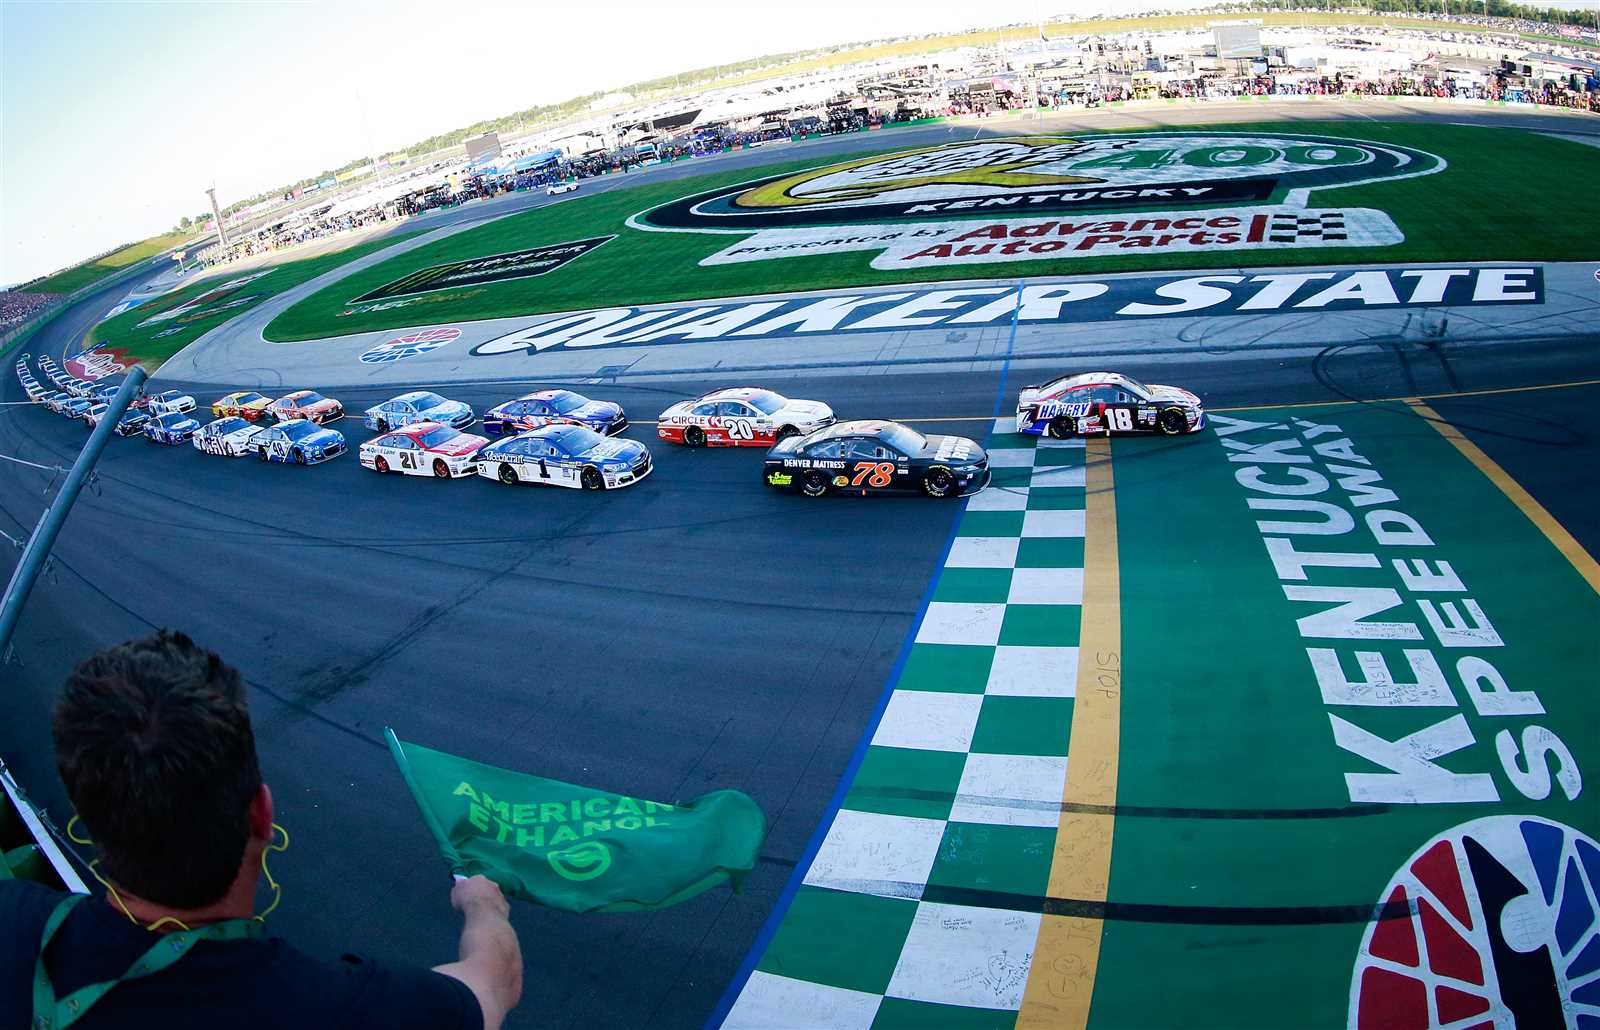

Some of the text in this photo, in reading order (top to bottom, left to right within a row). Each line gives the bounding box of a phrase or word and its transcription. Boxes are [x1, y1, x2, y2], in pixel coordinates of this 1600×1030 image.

[1070, 145, 1371, 170] 400
[903, 187, 1214, 214] KENTUCKY
[947, 214, 1241, 242] Advance
[727, 228, 955, 256] Presented by
[901, 231, 1241, 261] Auto Parts
[477, 268, 1536, 354] QUAKER STATE
[671, 415, 706, 425] CIRCLE
[723, 418, 754, 440] 20
[1104, 408, 1133, 430] 18
[399, 451, 418, 470] 21
[538, 456, 551, 479] 1
[784, 459, 846, 469] DENVER MATTRESS
[851, 461, 895, 488] 78
[1207, 413, 1500, 804] KENTUCKY
[1290, 416, 1583, 801] SPEEDWAY
[1096, 651, 1120, 699] STOP
[452, 781, 673, 826] AMERICAN
[469, 802, 672, 848] ETHANOL
